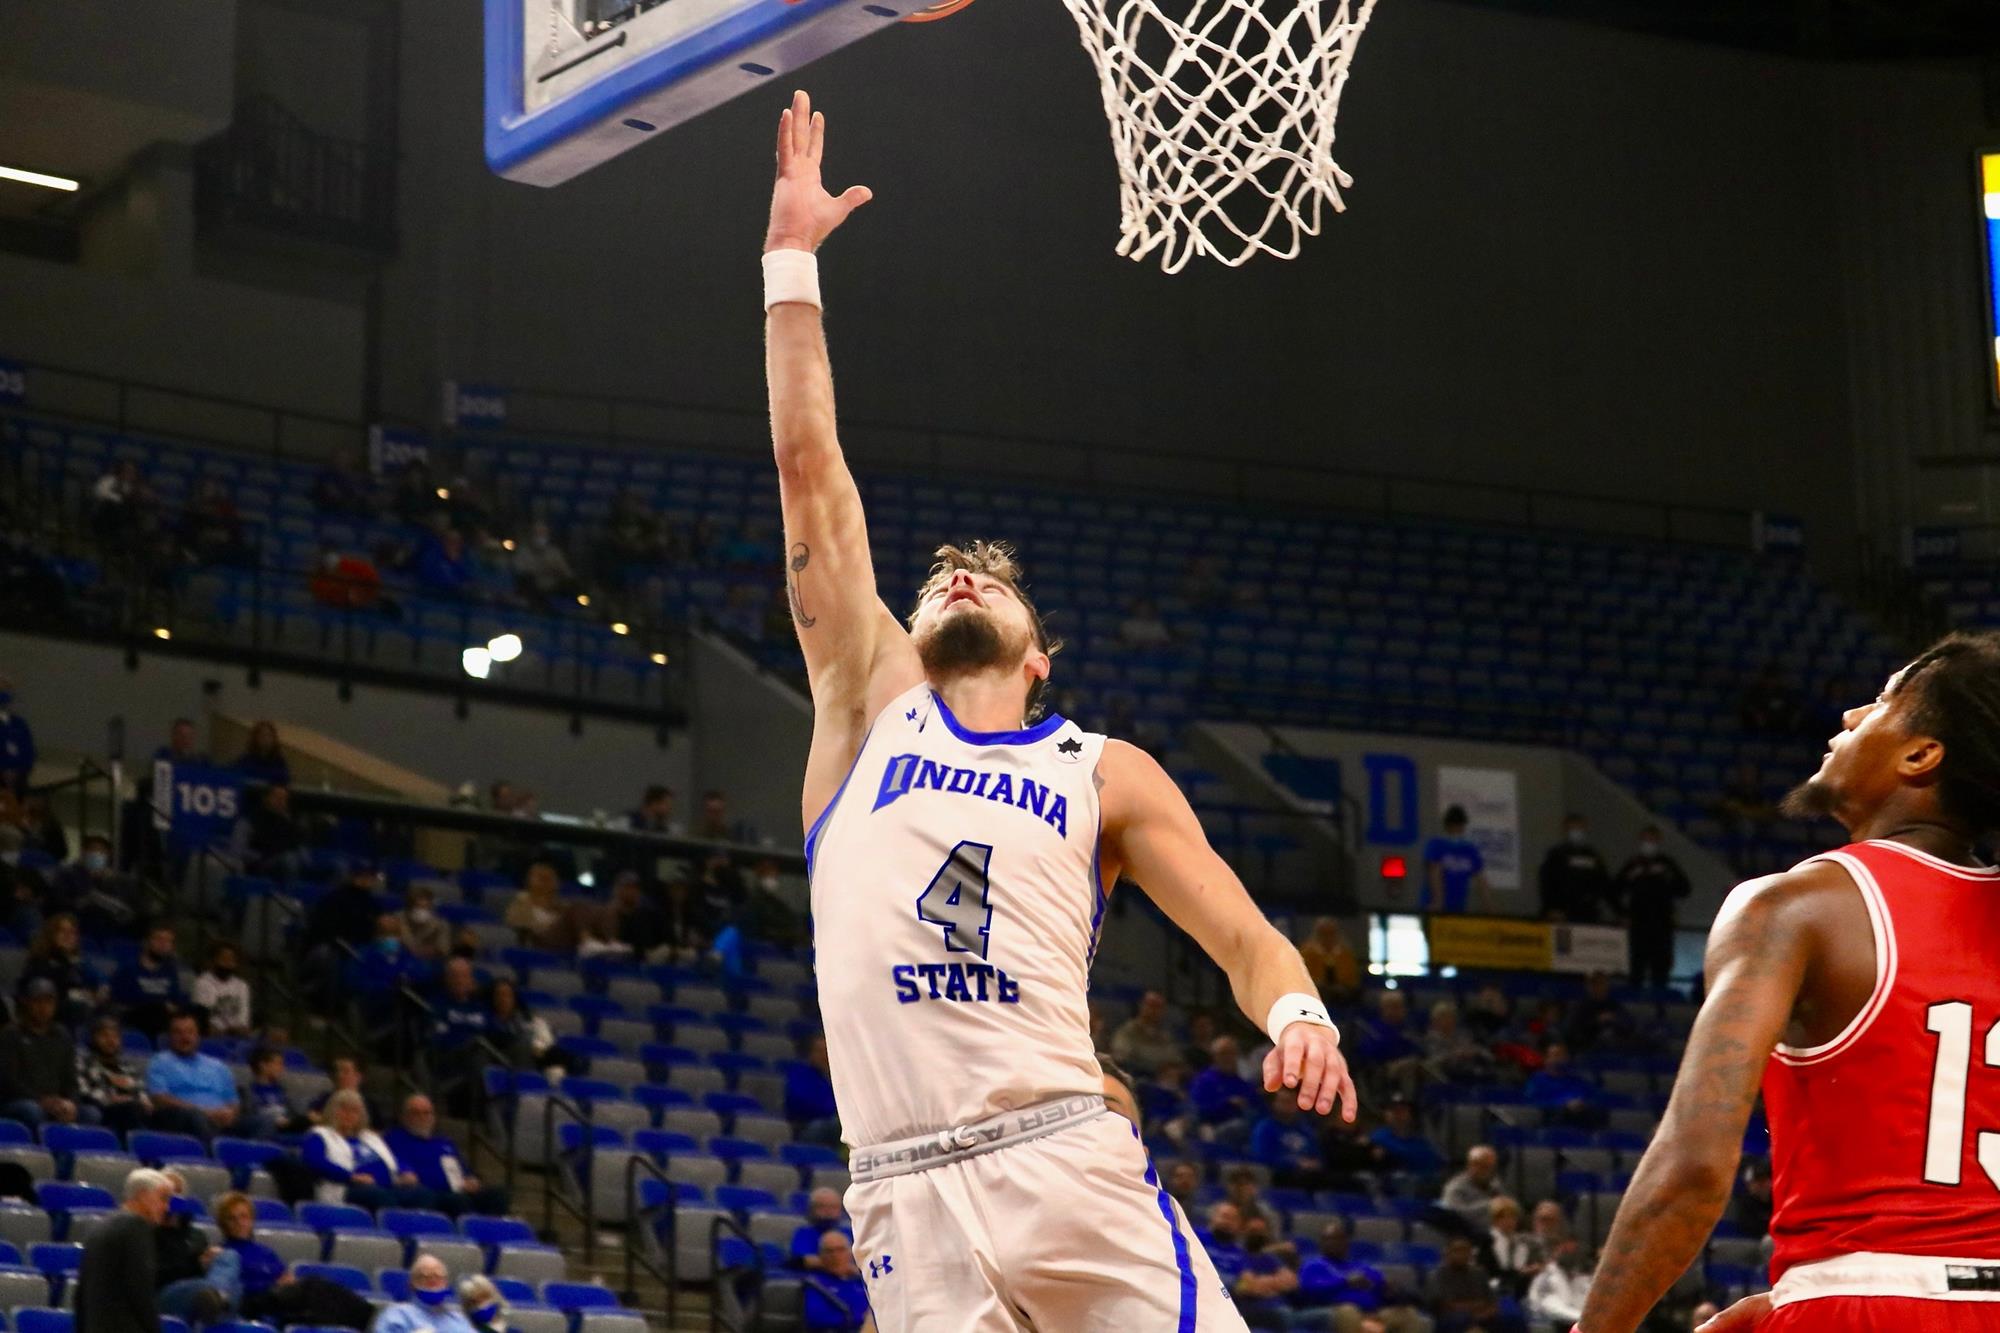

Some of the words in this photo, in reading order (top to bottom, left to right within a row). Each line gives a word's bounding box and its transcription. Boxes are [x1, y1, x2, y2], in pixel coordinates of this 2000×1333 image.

[177, 781, 239, 819] 105
[870, 753, 1067, 840] INDIANA
[1364, 755, 1418, 845] D
[916, 839, 994, 962] 4
[892, 963, 1020, 1005] STATE
[855, 1122, 1004, 1173] AMOUR
